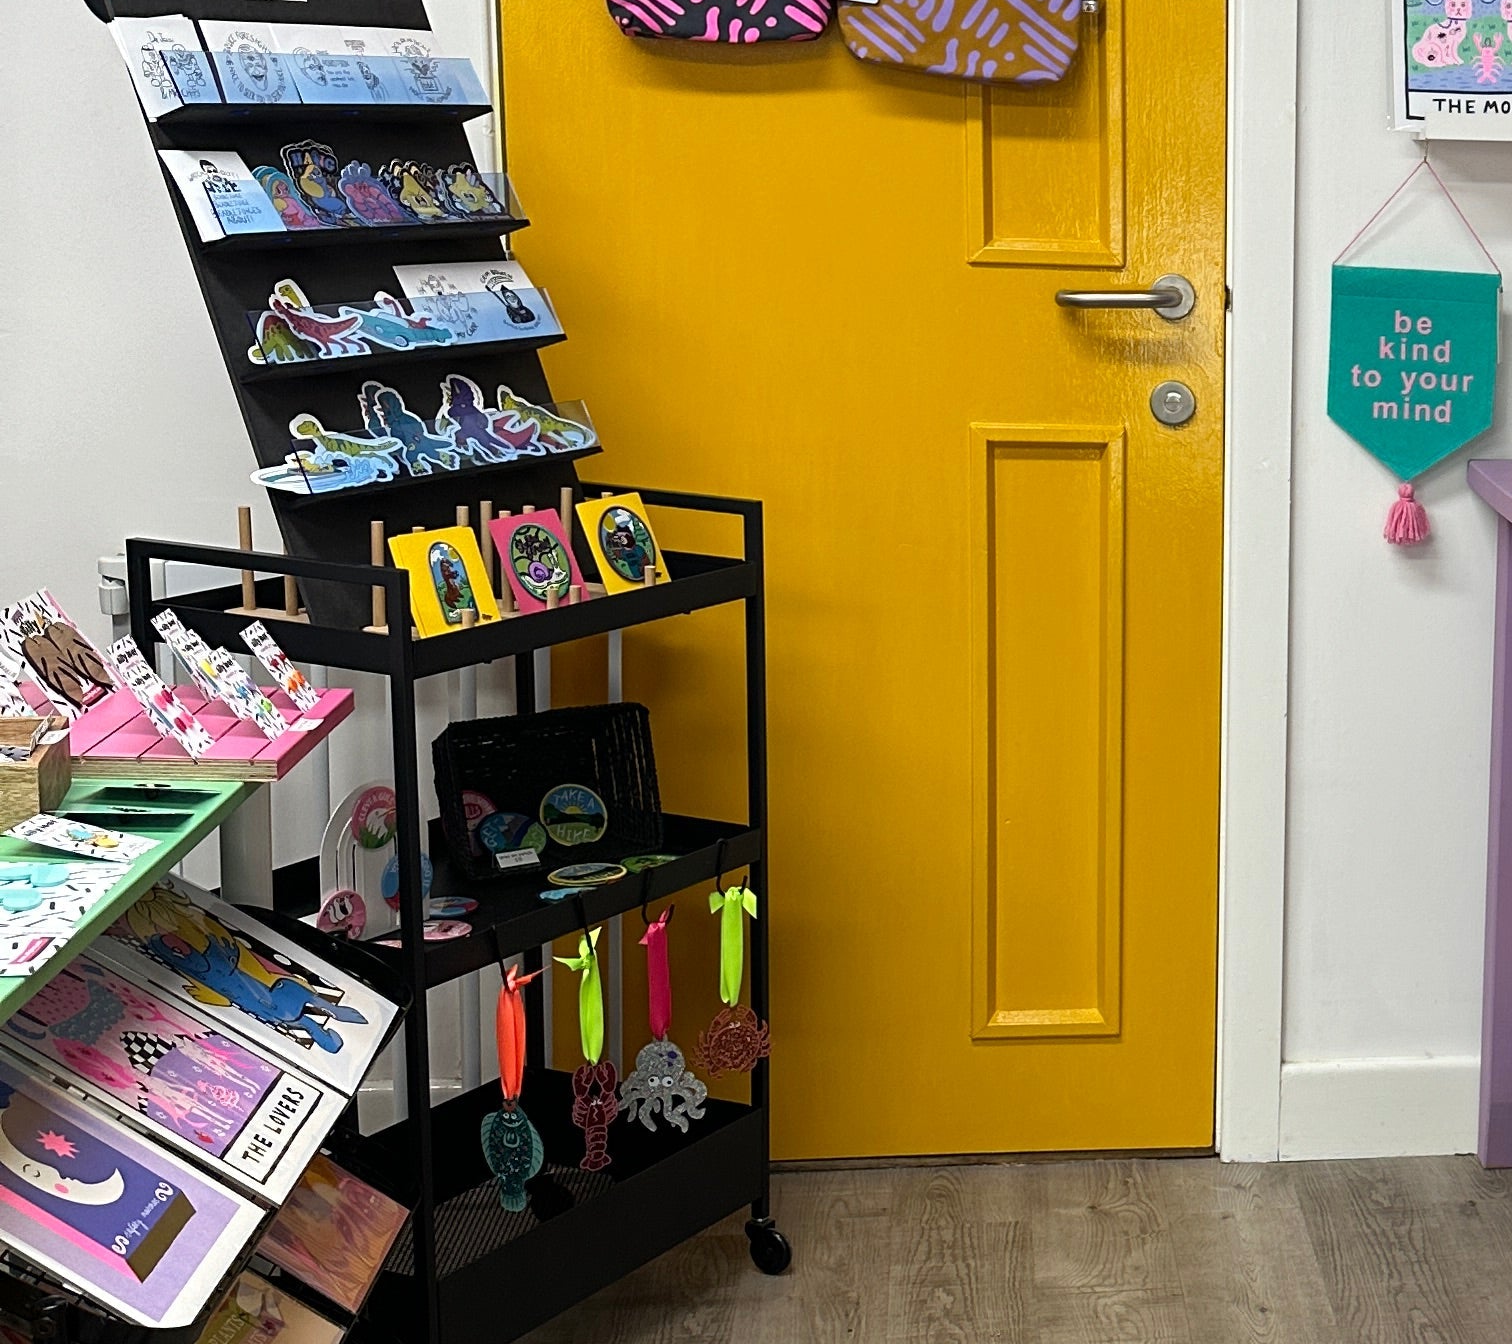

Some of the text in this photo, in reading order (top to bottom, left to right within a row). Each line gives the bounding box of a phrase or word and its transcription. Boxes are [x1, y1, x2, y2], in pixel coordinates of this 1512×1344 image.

[1432, 98, 1477, 114] THE
[1395, 309, 1432, 335] be
[1379, 336, 1451, 363] kind
[1350, 364, 1474, 395] to your
[1372, 396, 1452, 423] mind
[553, 788, 584, 805] TAKE
[556, 824, 593, 841] HIKE
[241, 1086, 306, 1164] THE LOVERS
